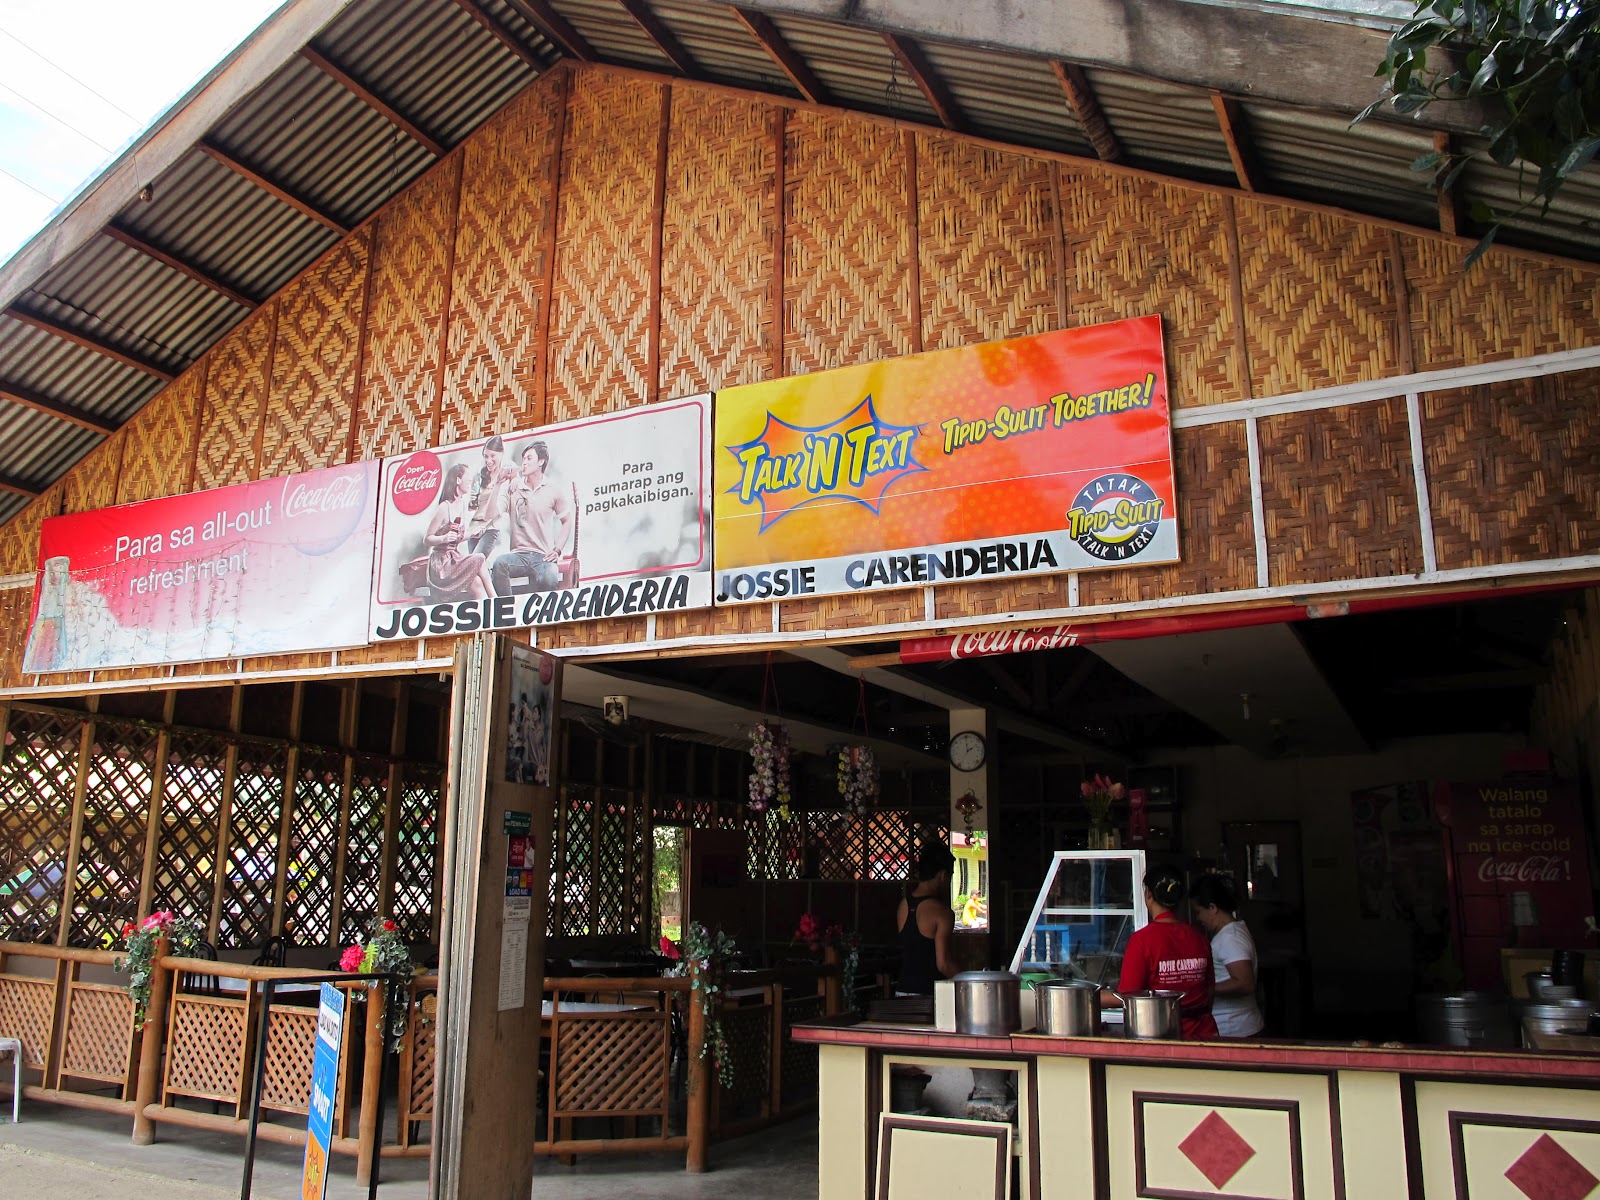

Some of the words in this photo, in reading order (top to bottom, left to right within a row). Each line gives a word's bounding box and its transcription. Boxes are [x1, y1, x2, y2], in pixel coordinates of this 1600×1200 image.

[941, 402, 1047, 454] TIPID-SULIT
[1050, 374, 1155, 425] TOGETHER!
[406, 465, 425, 475] Open
[622, 460, 654, 476] Para
[738, 445, 804, 503] TALK
[845, 424, 914, 487] TEXT
[285, 474, 366, 519] Coca-Cola
[394, 468, 441, 495] Coca-Cola
[593, 475, 652, 498] sumarap
[656, 470, 684, 490] ang
[1082, 477, 1141, 501] TATAK
[585, 484, 695, 516] pagkakaibigan.
[115, 534, 164, 562] Para
[169, 525, 195, 549] sa
[202, 502, 273, 541] all-out
[1068, 499, 1163, 540] TIPID-SULIT
[1081, 536, 1110, 558] TALK
[1114, 545, 1126, 558] 'N
[1128, 526, 1153, 553] TEXT
[129, 549, 250, 597] refreshment
[716, 566, 816, 604] JOSSIE
[845, 539, 1058, 590] CARENDERIA
[376, 598, 517, 639] JOSSIE
[522, 575, 688, 626] CARENDERIA
[1479, 787, 1548, 803] Walang
[1488, 804, 1542, 819] tatalo
[1480, 824, 1499, 836] sa
[1504, 823, 1555, 837] sarap
[1496, 838, 1571, 853] ice-cold
[1158, 959, 1176, 973] JOSIE
[313, 1082, 331, 1123] SMART
